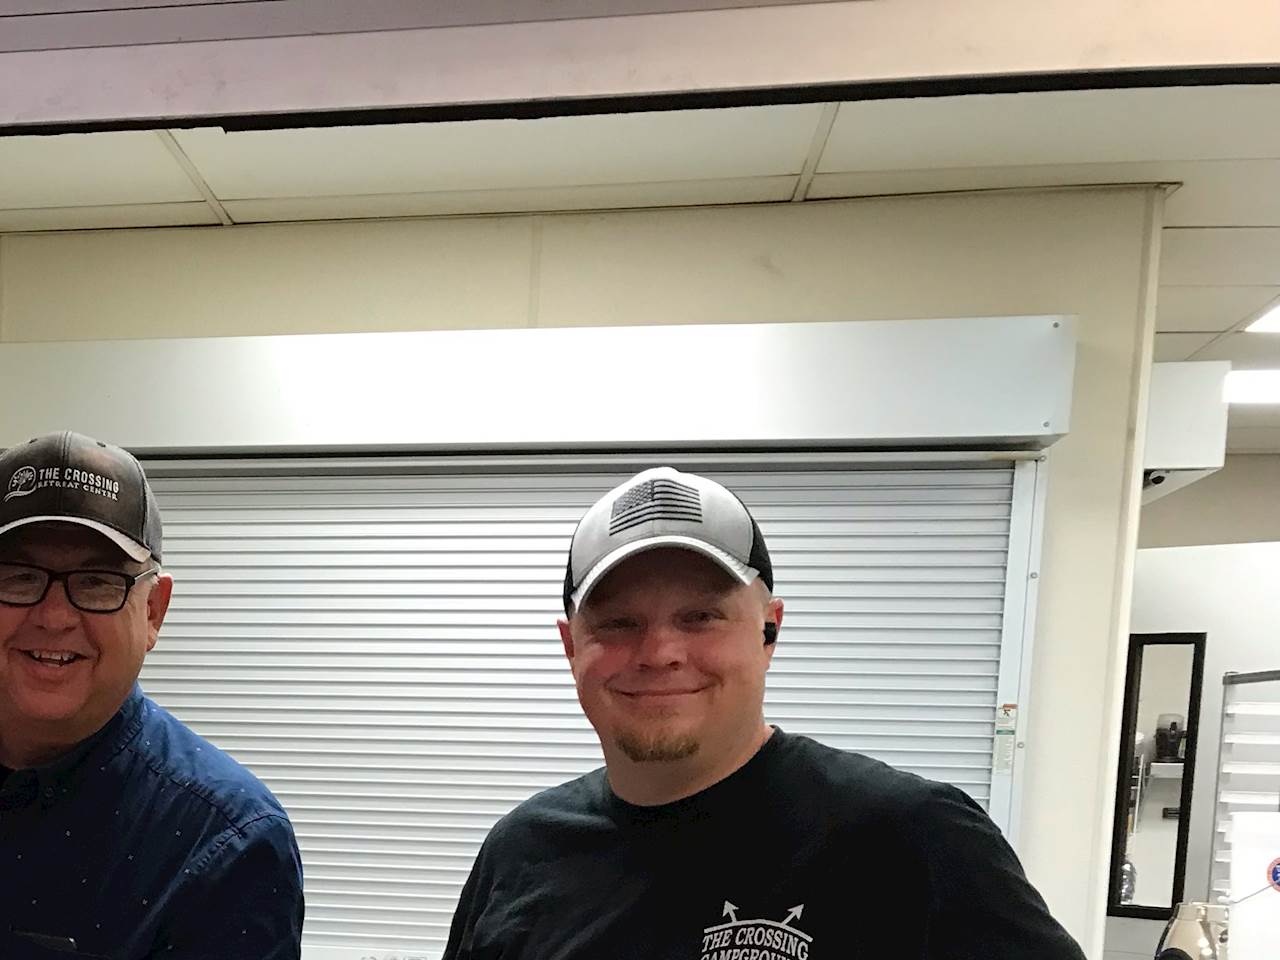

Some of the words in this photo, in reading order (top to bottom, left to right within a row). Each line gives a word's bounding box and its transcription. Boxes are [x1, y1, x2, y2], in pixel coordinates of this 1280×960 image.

[37, 480, 80, 489] RETREAT
[83, 484, 118, 501] CENTER
[39, 467, 60, 480] THE
[64, 468, 119, 493] CROSSING
[701, 929, 733, 953] THE
